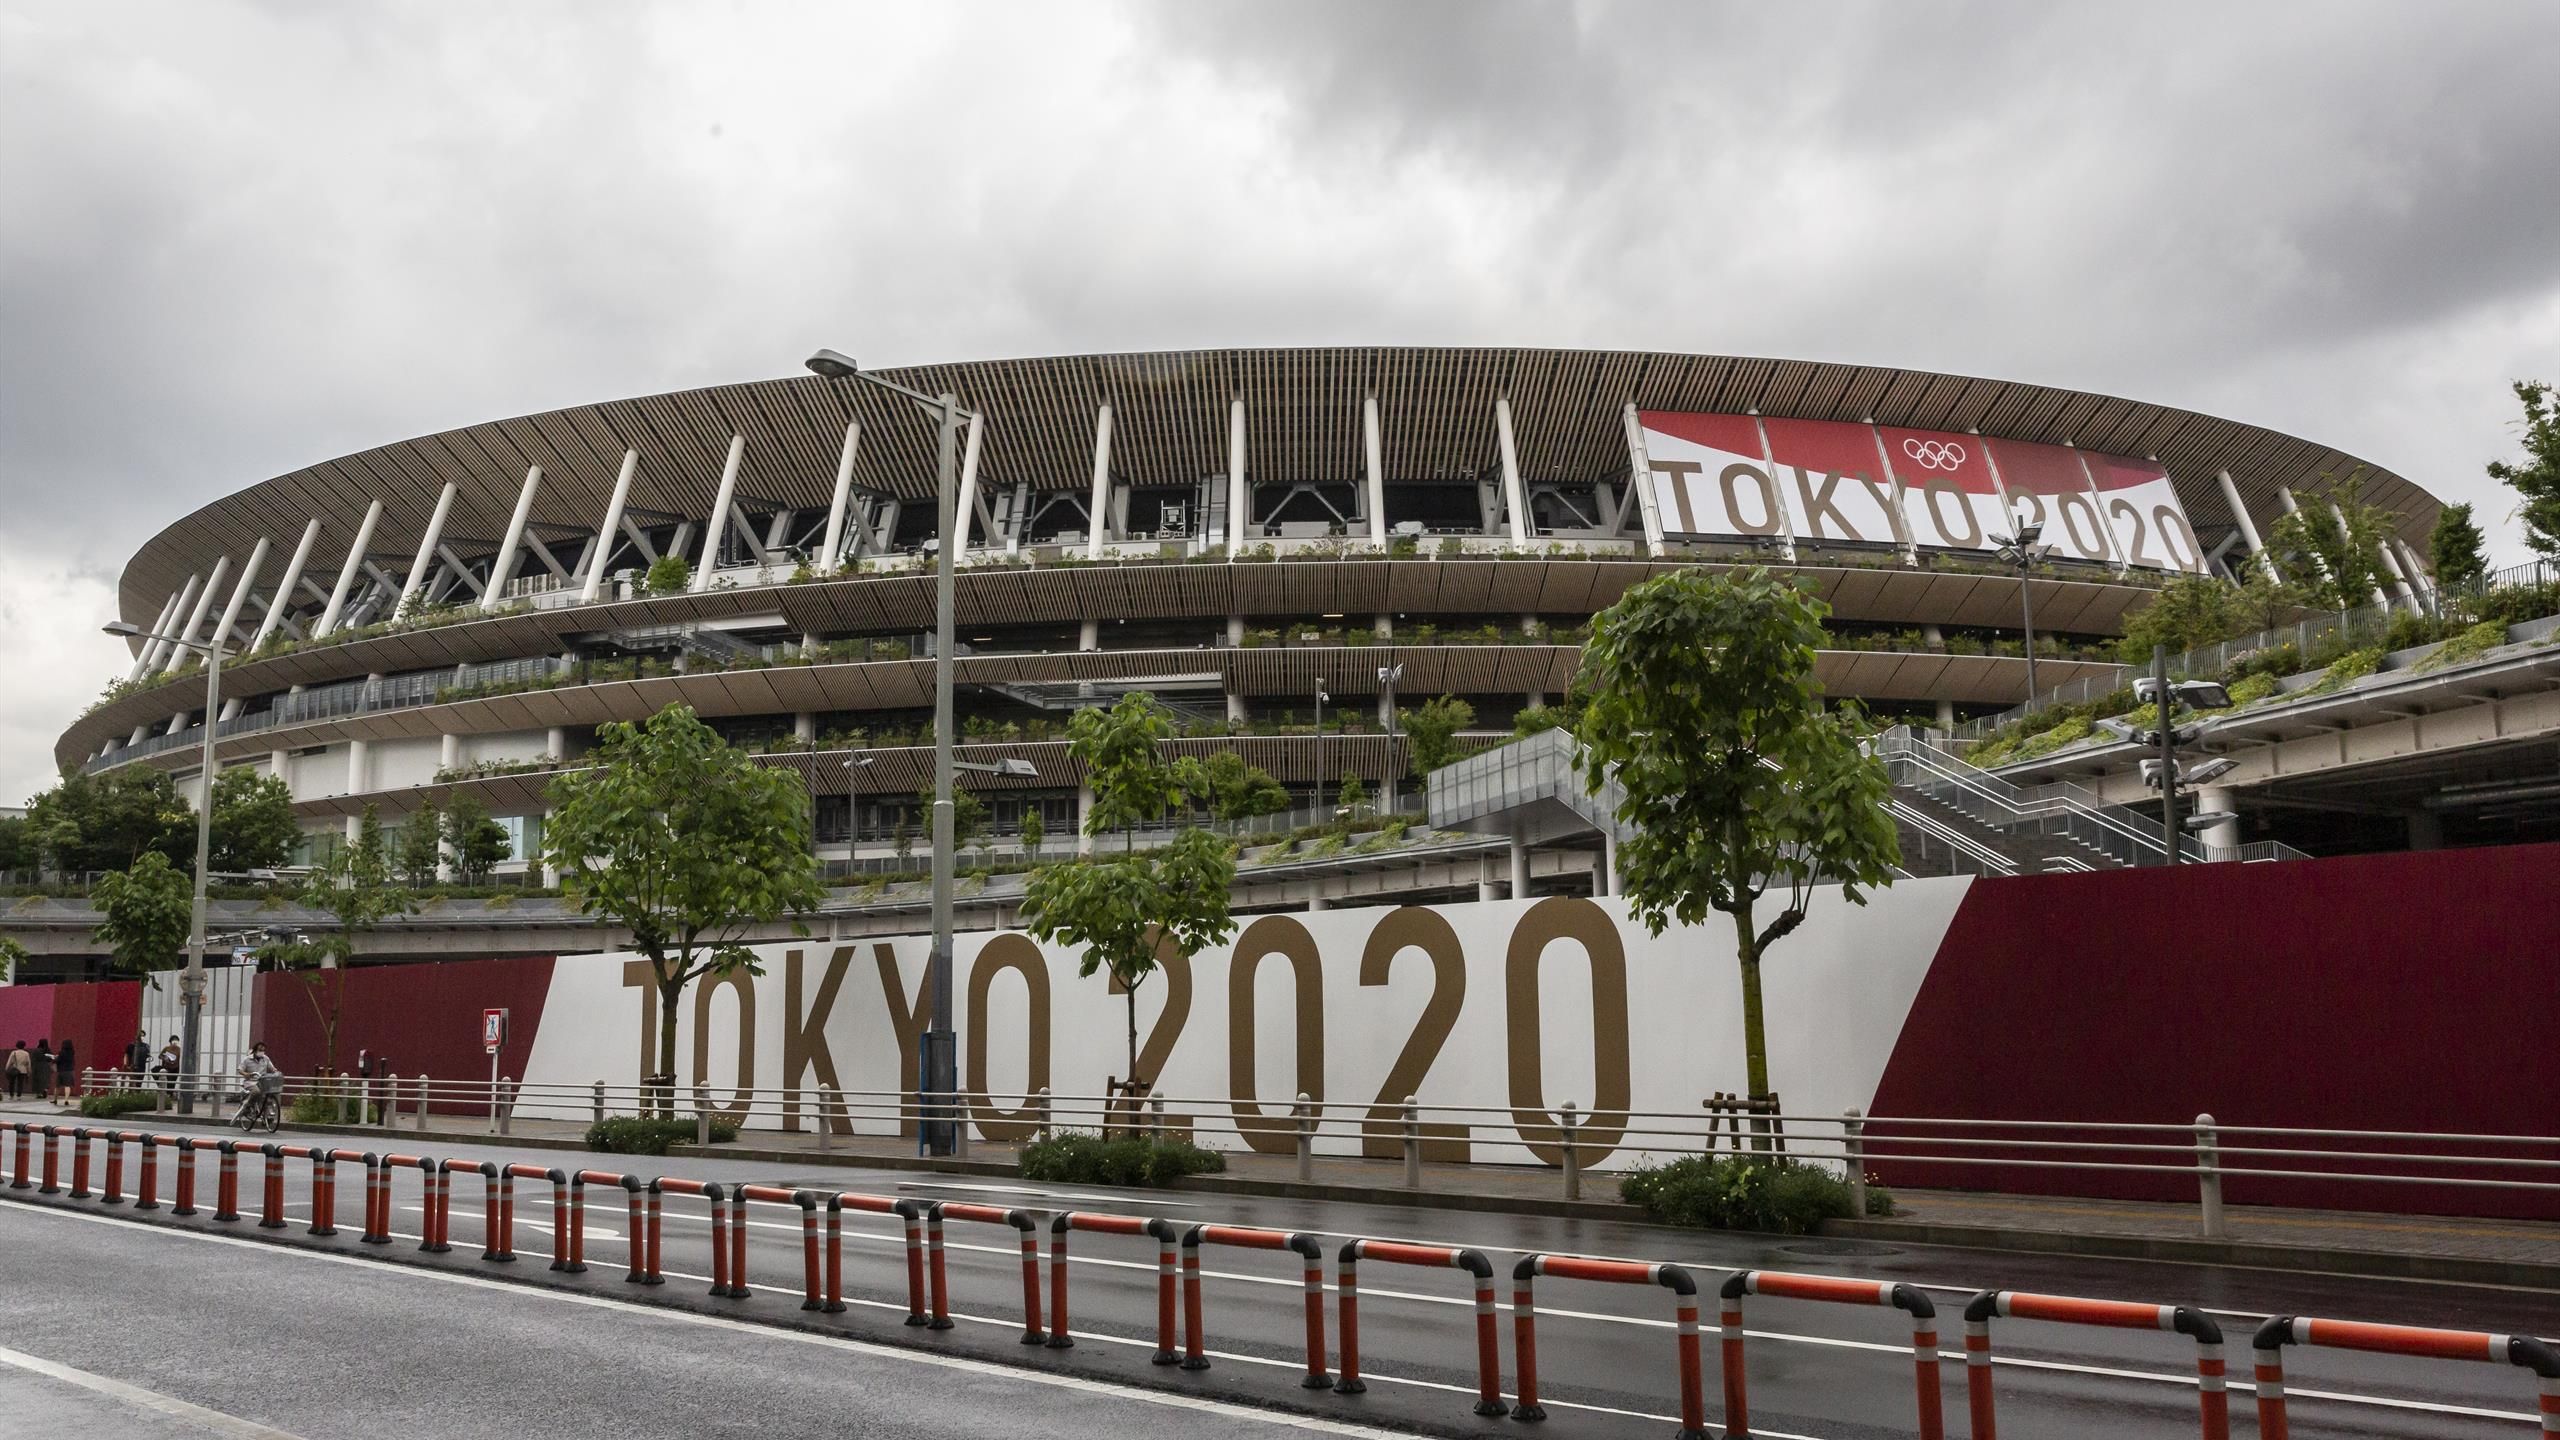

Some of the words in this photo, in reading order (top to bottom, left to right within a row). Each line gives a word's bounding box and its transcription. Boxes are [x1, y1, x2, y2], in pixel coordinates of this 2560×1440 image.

[1648, 460, 1982, 549] TOKYO
[2009, 485, 2204, 573] 2020
[623, 933, 1051, 1141] TOKYO
[1108, 895, 1631, 1168] 2020
